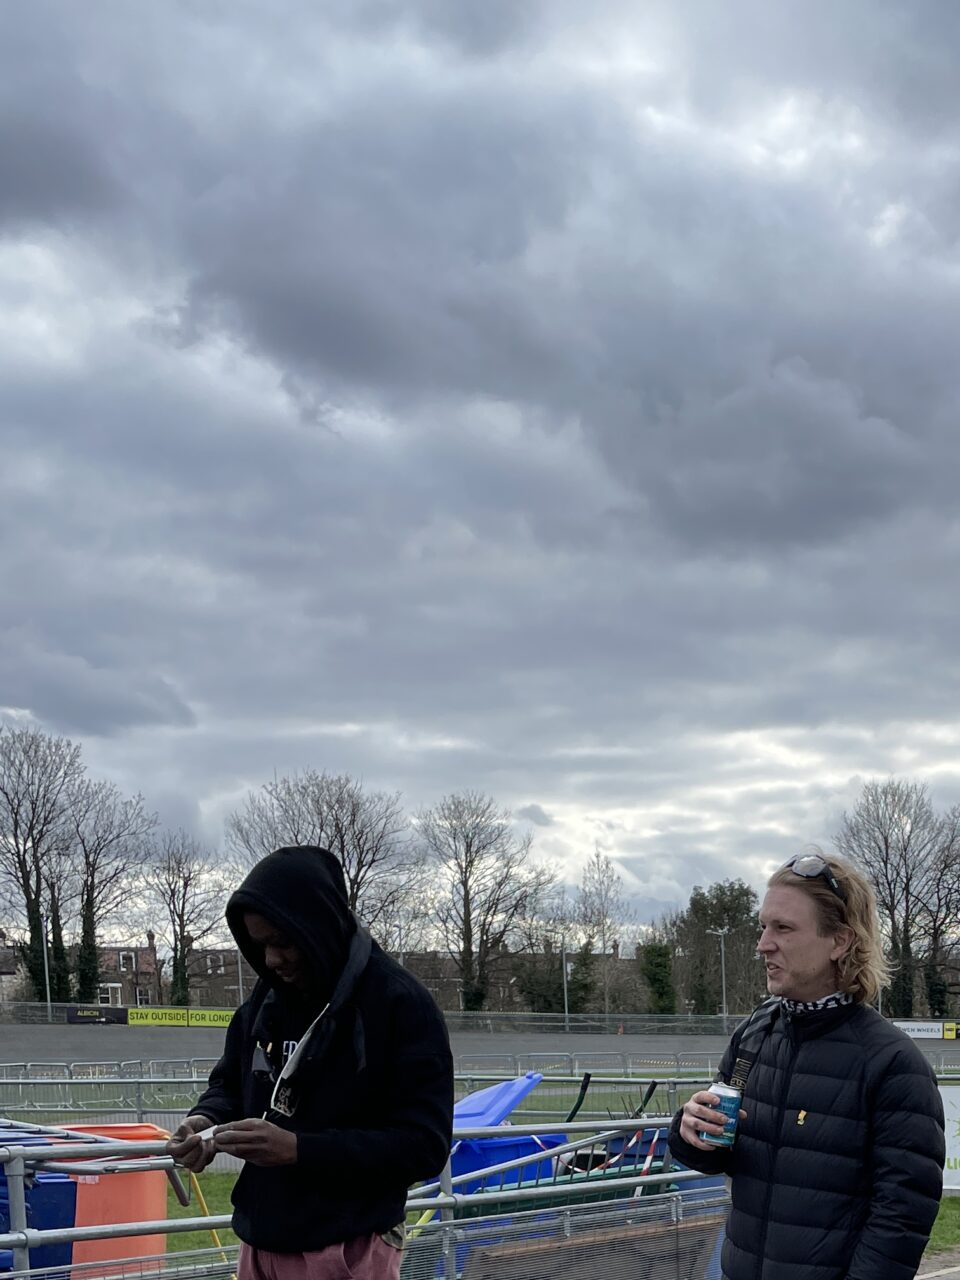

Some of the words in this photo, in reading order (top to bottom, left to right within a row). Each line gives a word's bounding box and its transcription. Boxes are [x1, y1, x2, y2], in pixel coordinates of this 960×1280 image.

[129, 1012, 149, 1020] STAY
[151, 1012, 186, 1021] OUTSIDE
[190, 1013, 206, 1021] FOR
[208, 1014, 233, 1022] LONG
